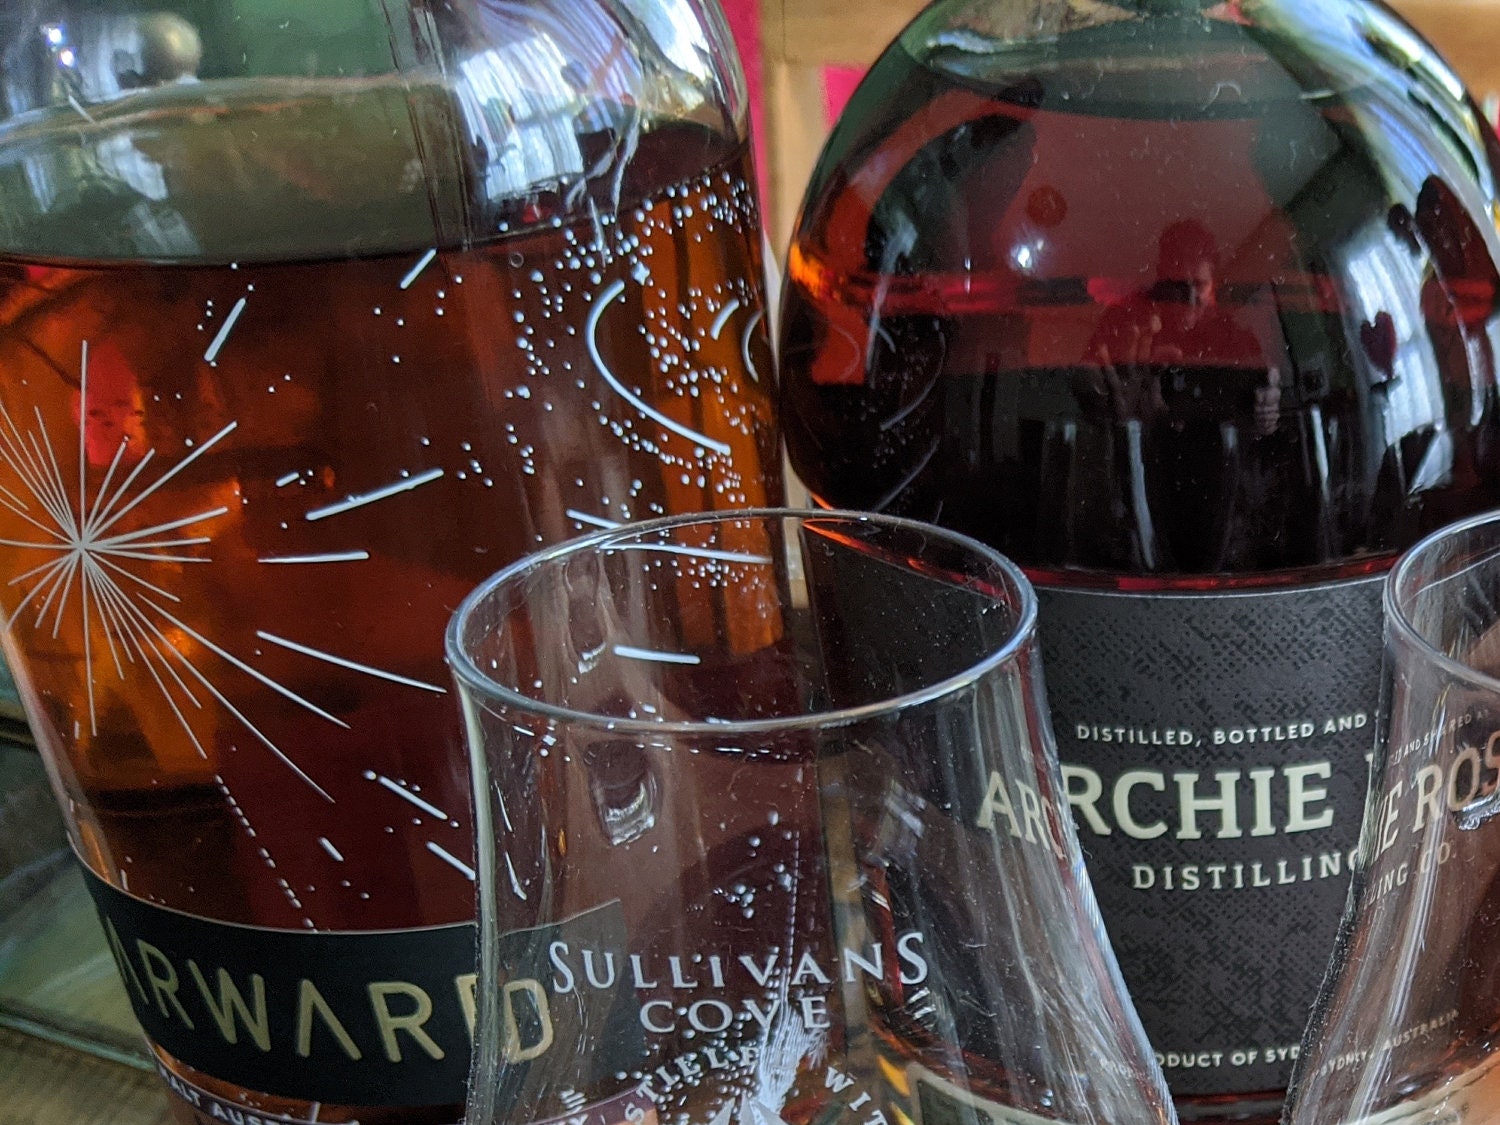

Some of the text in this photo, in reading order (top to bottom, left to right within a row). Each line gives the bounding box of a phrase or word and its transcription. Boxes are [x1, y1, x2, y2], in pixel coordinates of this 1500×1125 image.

[1076, 723, 1202, 747] DISTILLED,
[1213, 722, 1314, 746] BOTTLED
[1323, 712, 1367, 736] AND
[548, 931, 930, 994] SULLIVANS
[639, 994, 832, 1034] COVE
[1231, 1051, 1257, 1065] OF
